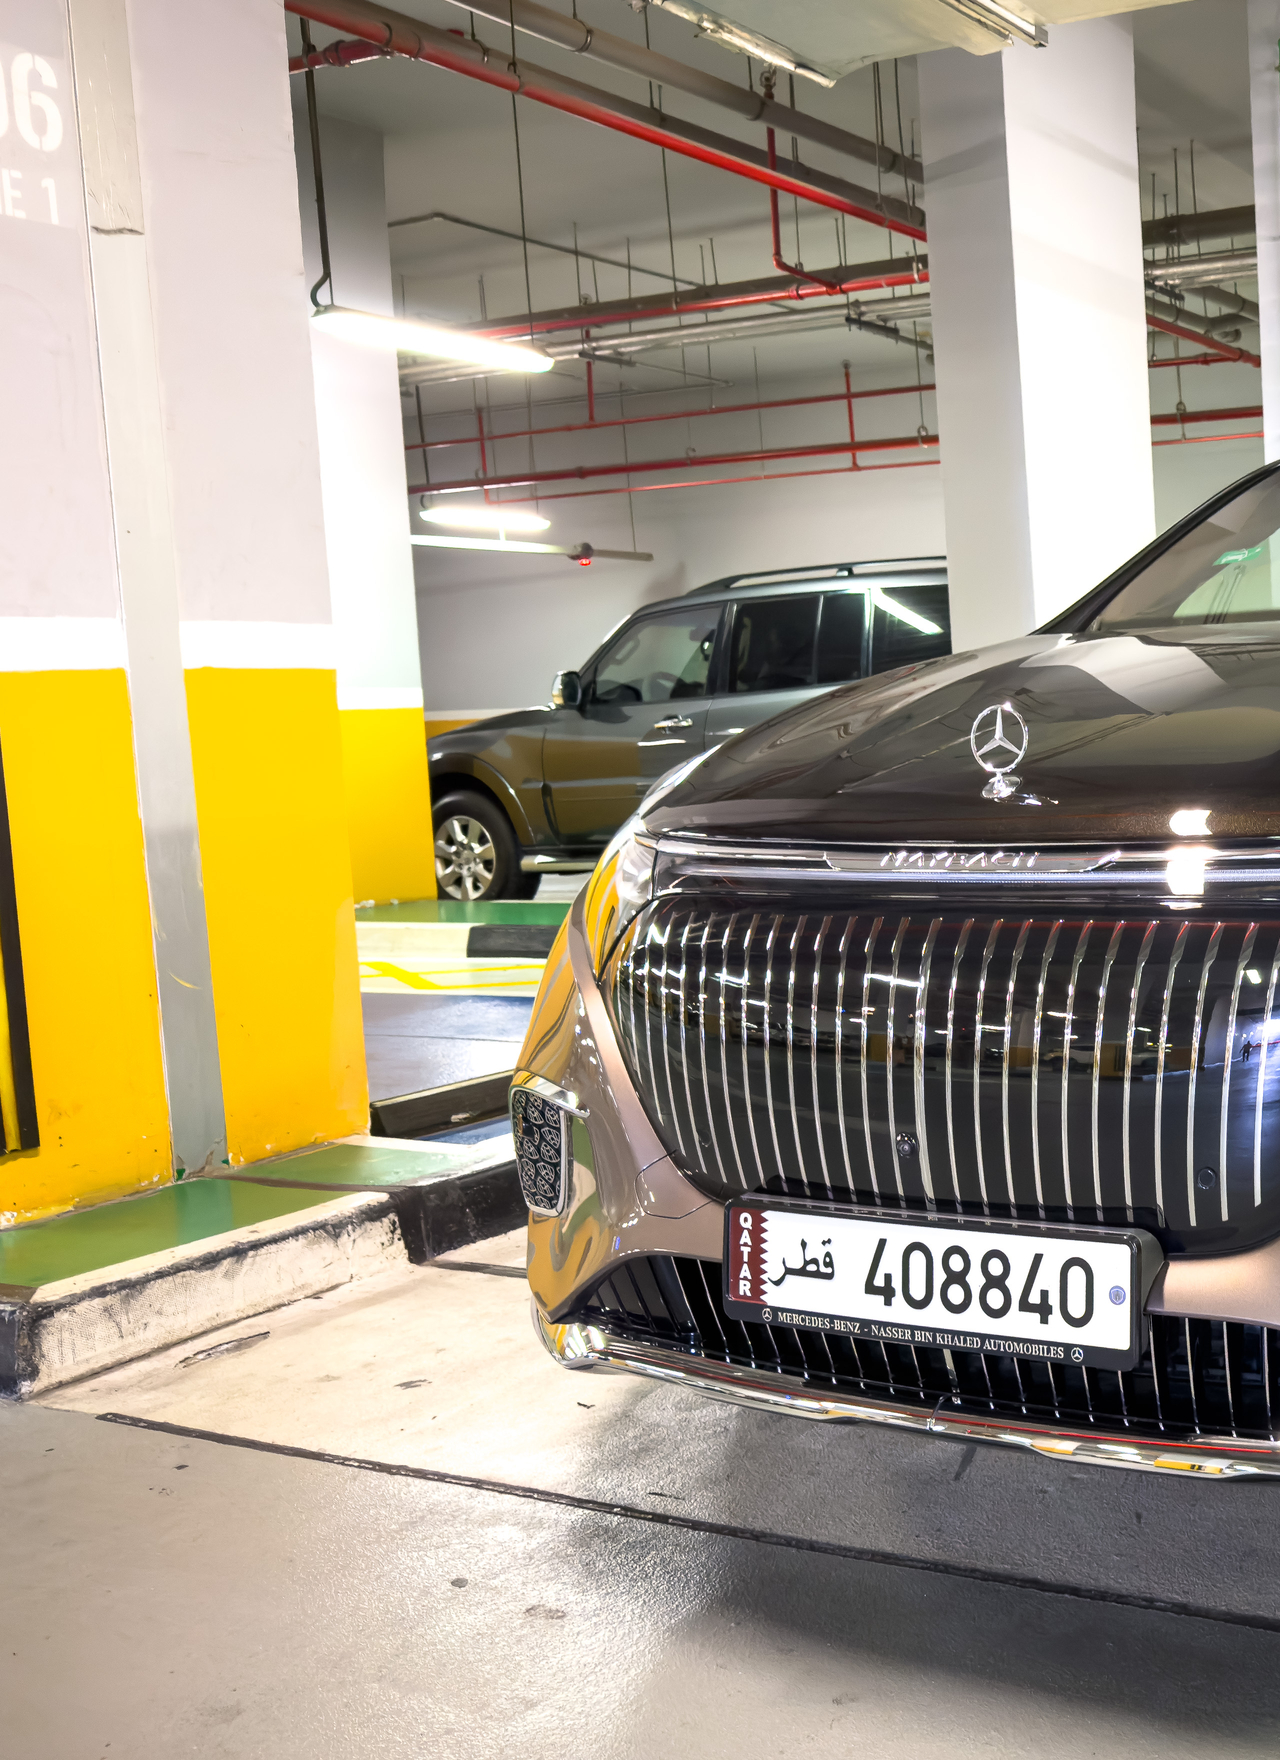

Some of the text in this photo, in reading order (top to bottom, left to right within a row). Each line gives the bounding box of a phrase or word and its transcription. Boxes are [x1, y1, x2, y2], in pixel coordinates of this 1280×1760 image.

[0, 52, 64, 152] 6
[0, 168, 60, 225] E 1
[880, 851, 1040, 868] MAYBACH
[739, 1212, 753, 1297] QATAR
[767, 1238, 835, 1287] قطر
[864, 1237, 1095, 1329] 408840
[777, 1311, 861, 1334] MERCEDES-BENZ
[871, 1324, 912, 1341] NASSER
[914, 1330, 933, 1344] BIN
[936, 1332, 981, 1349] KHALED
[983, 1338, 1065, 1359] AUTOMOBILES
